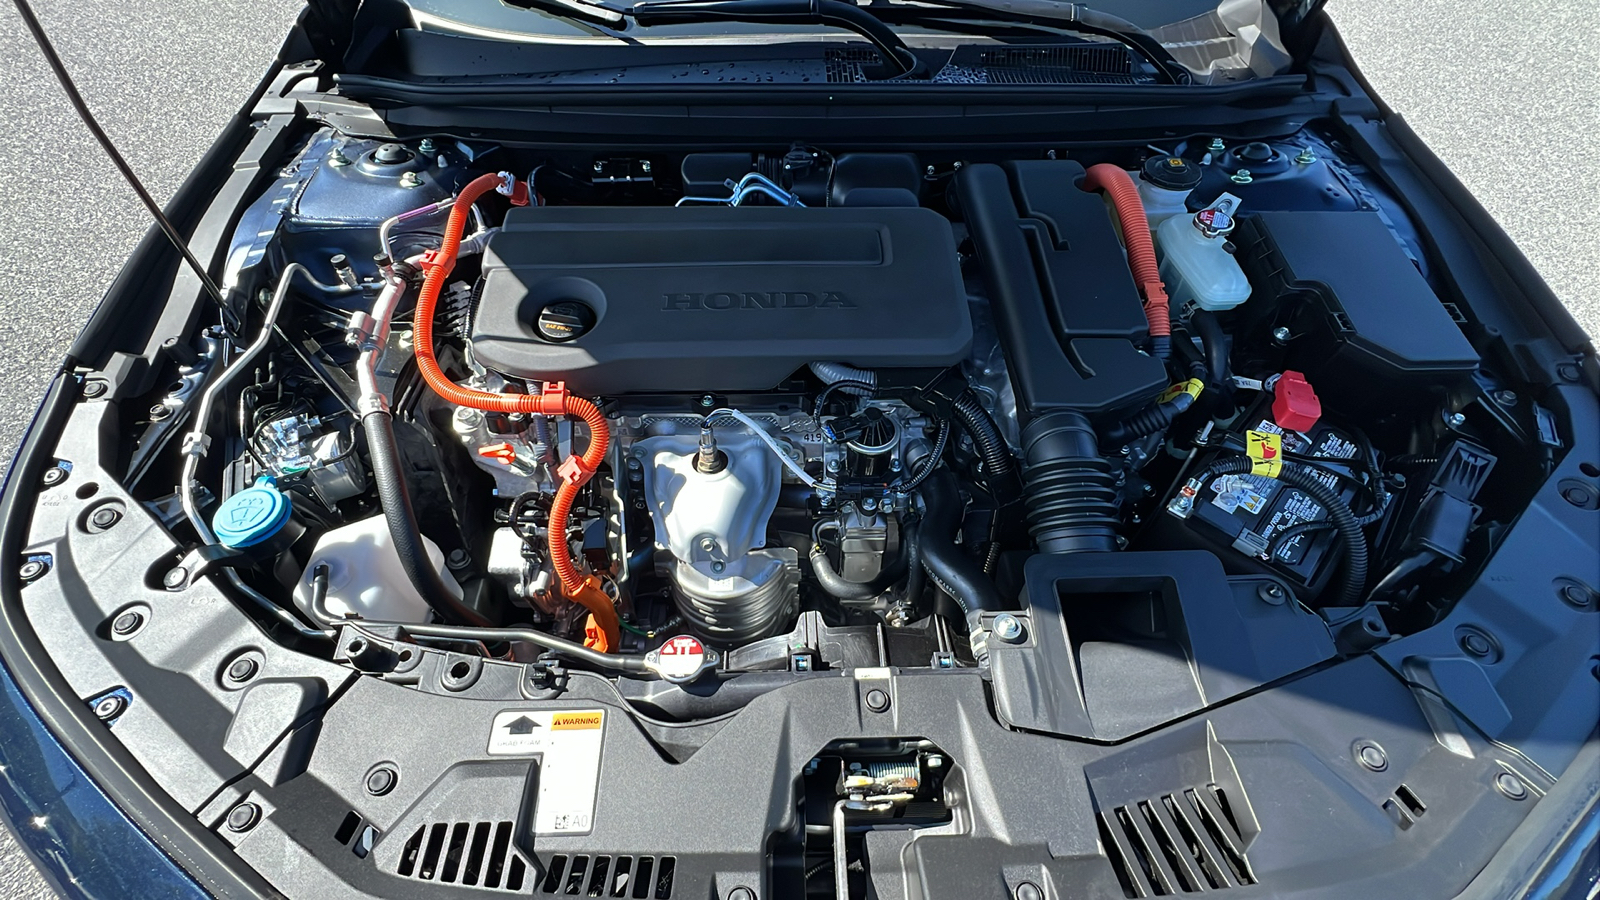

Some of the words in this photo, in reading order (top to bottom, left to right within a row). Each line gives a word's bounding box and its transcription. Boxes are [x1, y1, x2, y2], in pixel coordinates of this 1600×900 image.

[660, 291, 858, 312] HONDA
[803, 433, 822, 442] 419
[562, 717, 600, 725] WARNING
